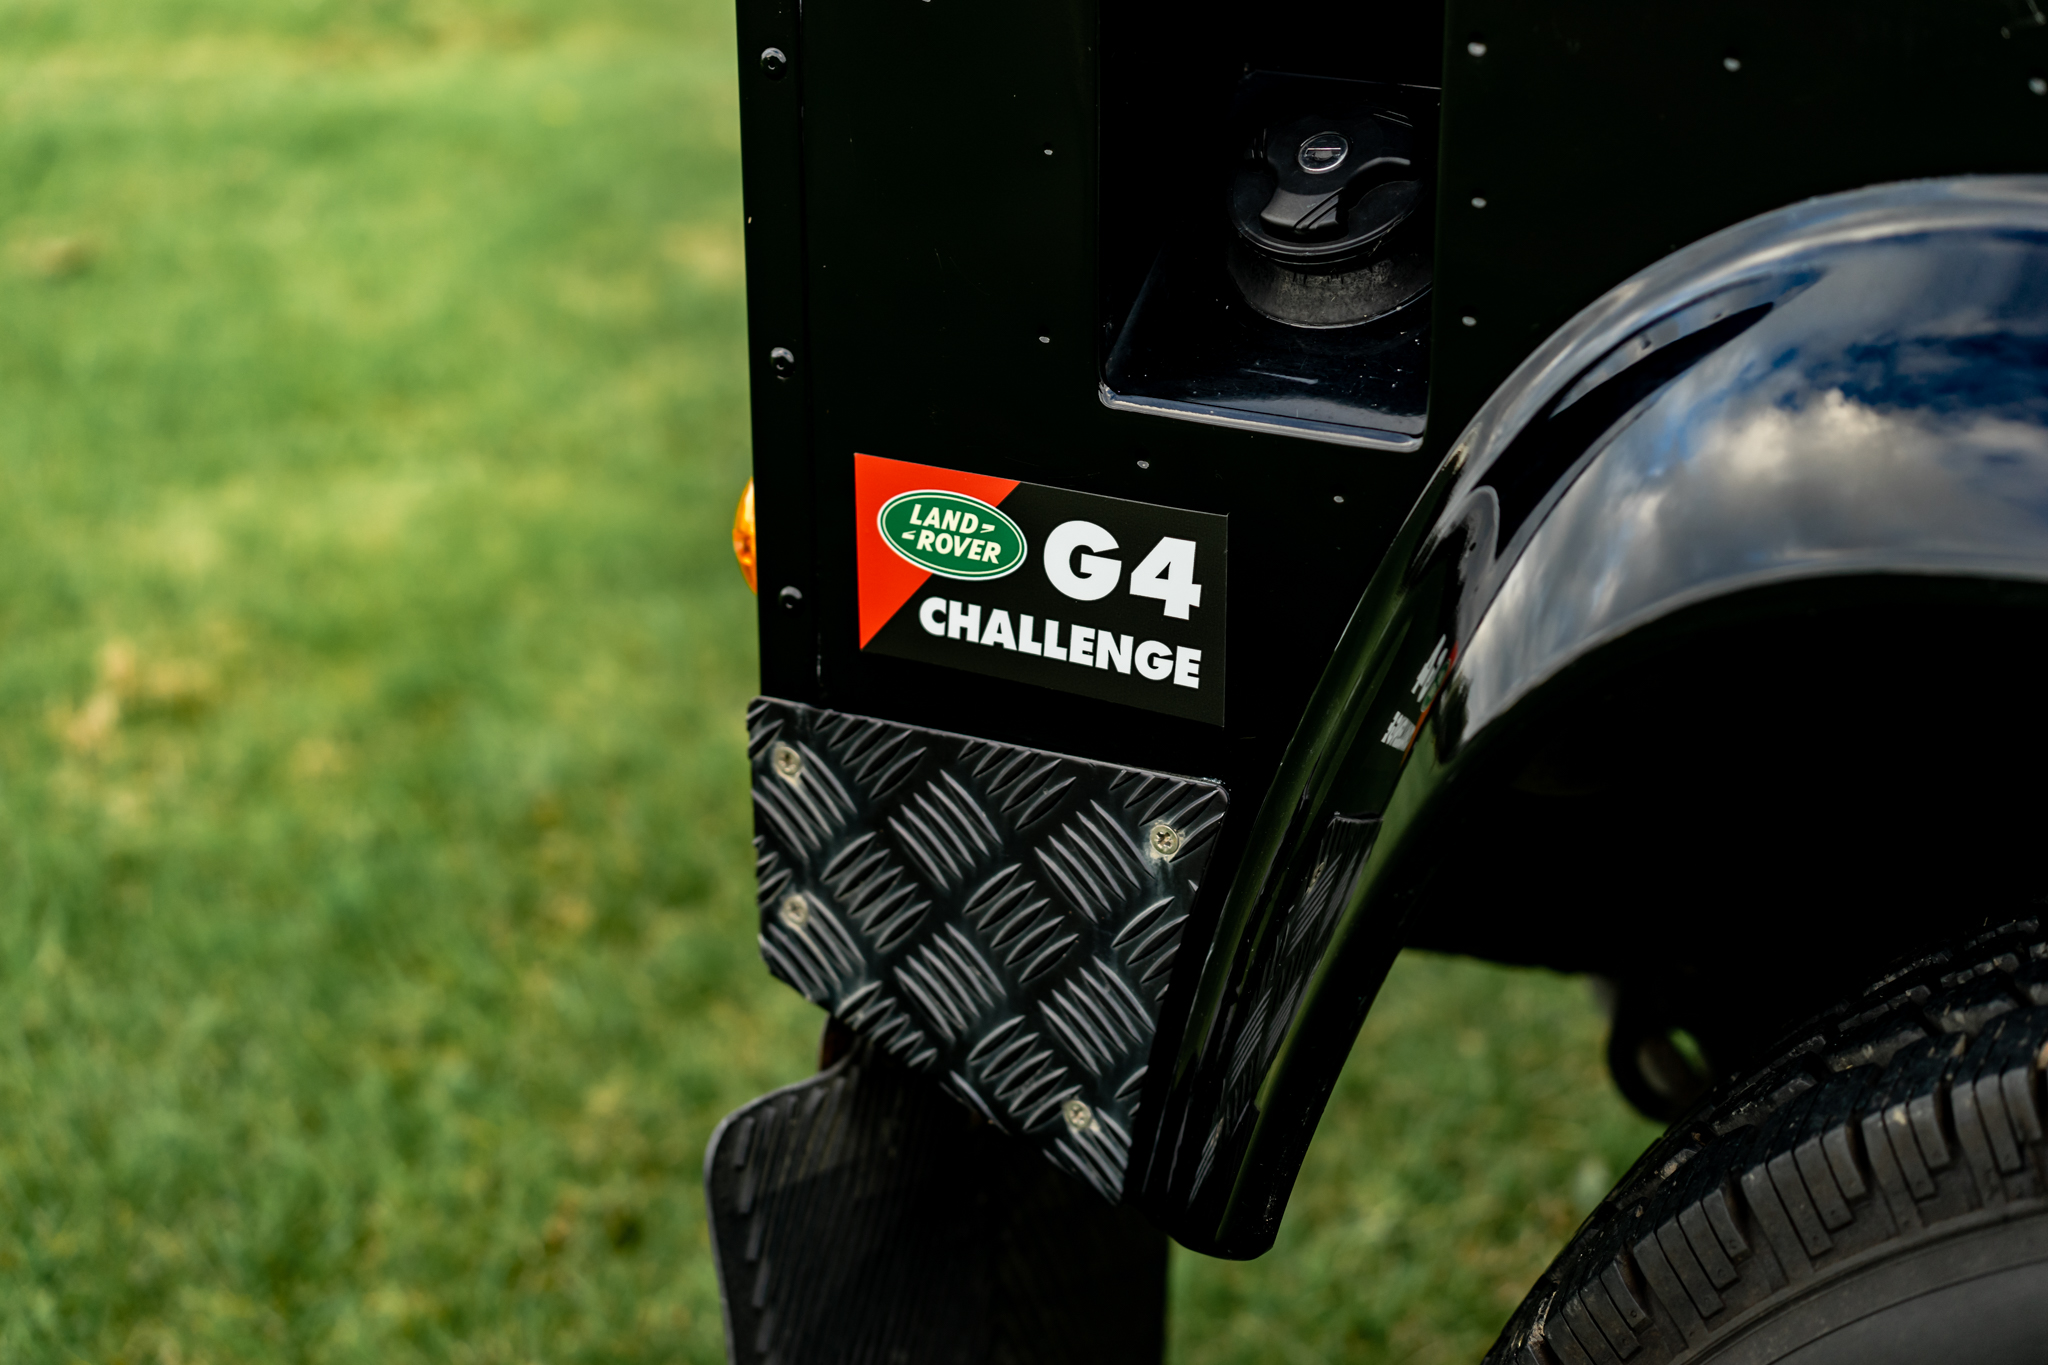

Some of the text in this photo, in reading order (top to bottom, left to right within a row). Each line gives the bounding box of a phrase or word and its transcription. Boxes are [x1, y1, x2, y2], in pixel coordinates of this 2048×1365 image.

[909, 504, 979, 534] LAND
[916, 530, 1001, 564] ROVER
[1043, 520, 1202, 620] G4
[919, 596, 1202, 689] CHALLENGE
